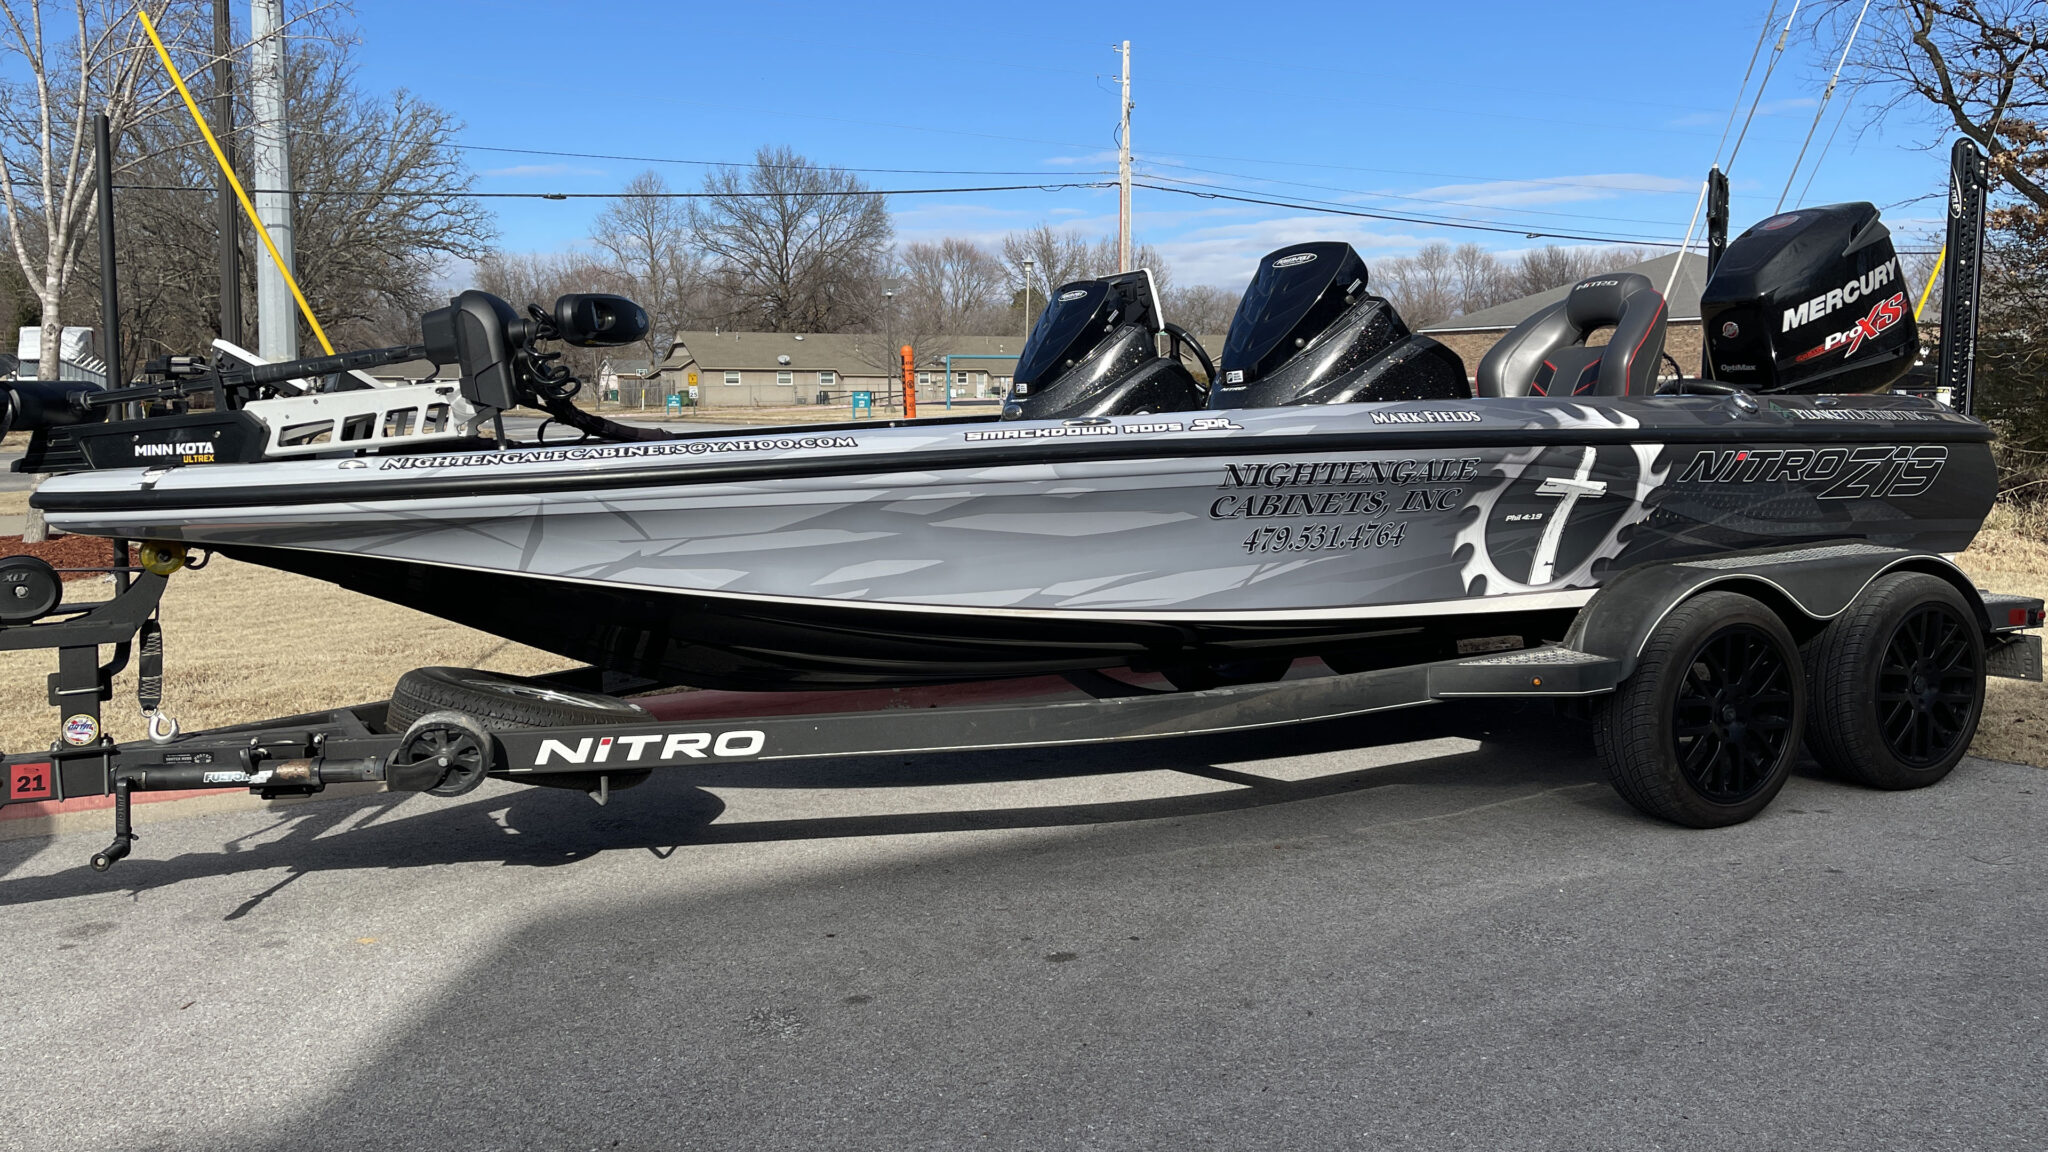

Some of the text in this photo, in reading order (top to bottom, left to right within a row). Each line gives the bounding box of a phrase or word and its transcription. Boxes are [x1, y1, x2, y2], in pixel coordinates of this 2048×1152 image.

[1782, 256, 1896, 333] MERCURY
[965, 418, 1243, 441] SMACKDOWN RODS SDR
[1369, 410, 1482, 424] MARK FIELDS
[134, 441, 215, 457] MINN KOTA
[183, 454, 214, 463] ULTREX
[380, 437, 857, 470] NIGHTENGALECABINETS@YAHOO.COM
[1217, 458, 1481, 489] NIGHTENGALE
[1816, 446, 1949, 499] Z19
[1209, 488, 1462, 519] CABINETS, INC
[1521, 513, 1543, 521] 4:19
[1241, 521, 1407, 554] 479.531.4764
[17, 774, 46, 792] 21
